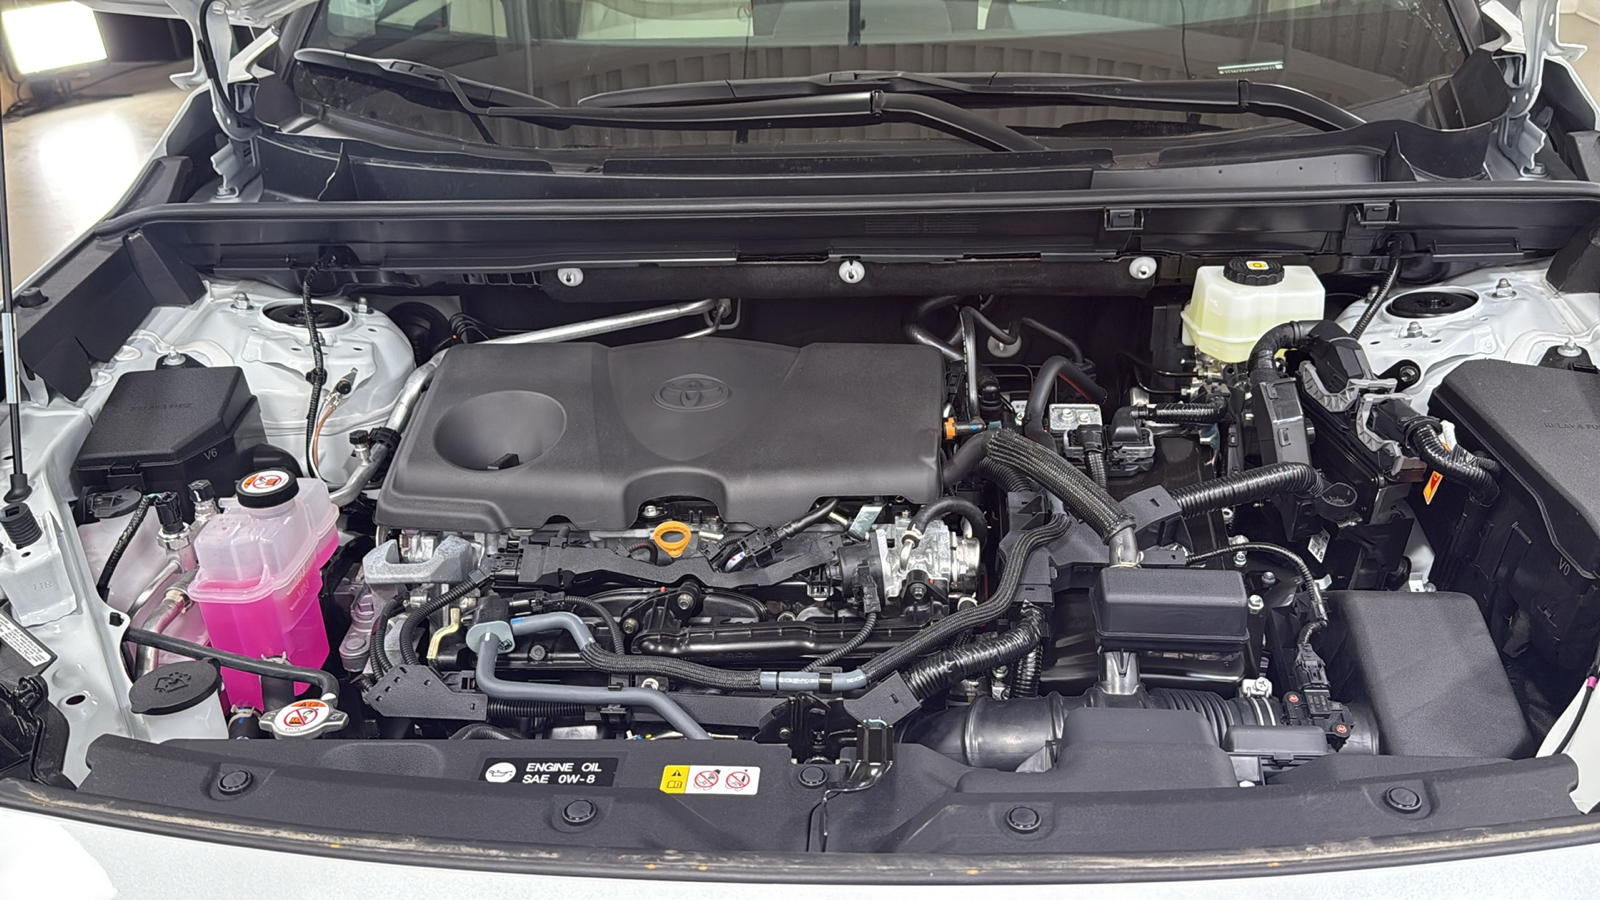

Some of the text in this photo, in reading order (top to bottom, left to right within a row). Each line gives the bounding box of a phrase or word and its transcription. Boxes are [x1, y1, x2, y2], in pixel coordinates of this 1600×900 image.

[1585, 423, 1600, 431] FU
[203, 448, 218, 461] V6
[525, 762, 602, 772] ENGINE OIL
[522, 773, 595, 785] SAE 0W-8
